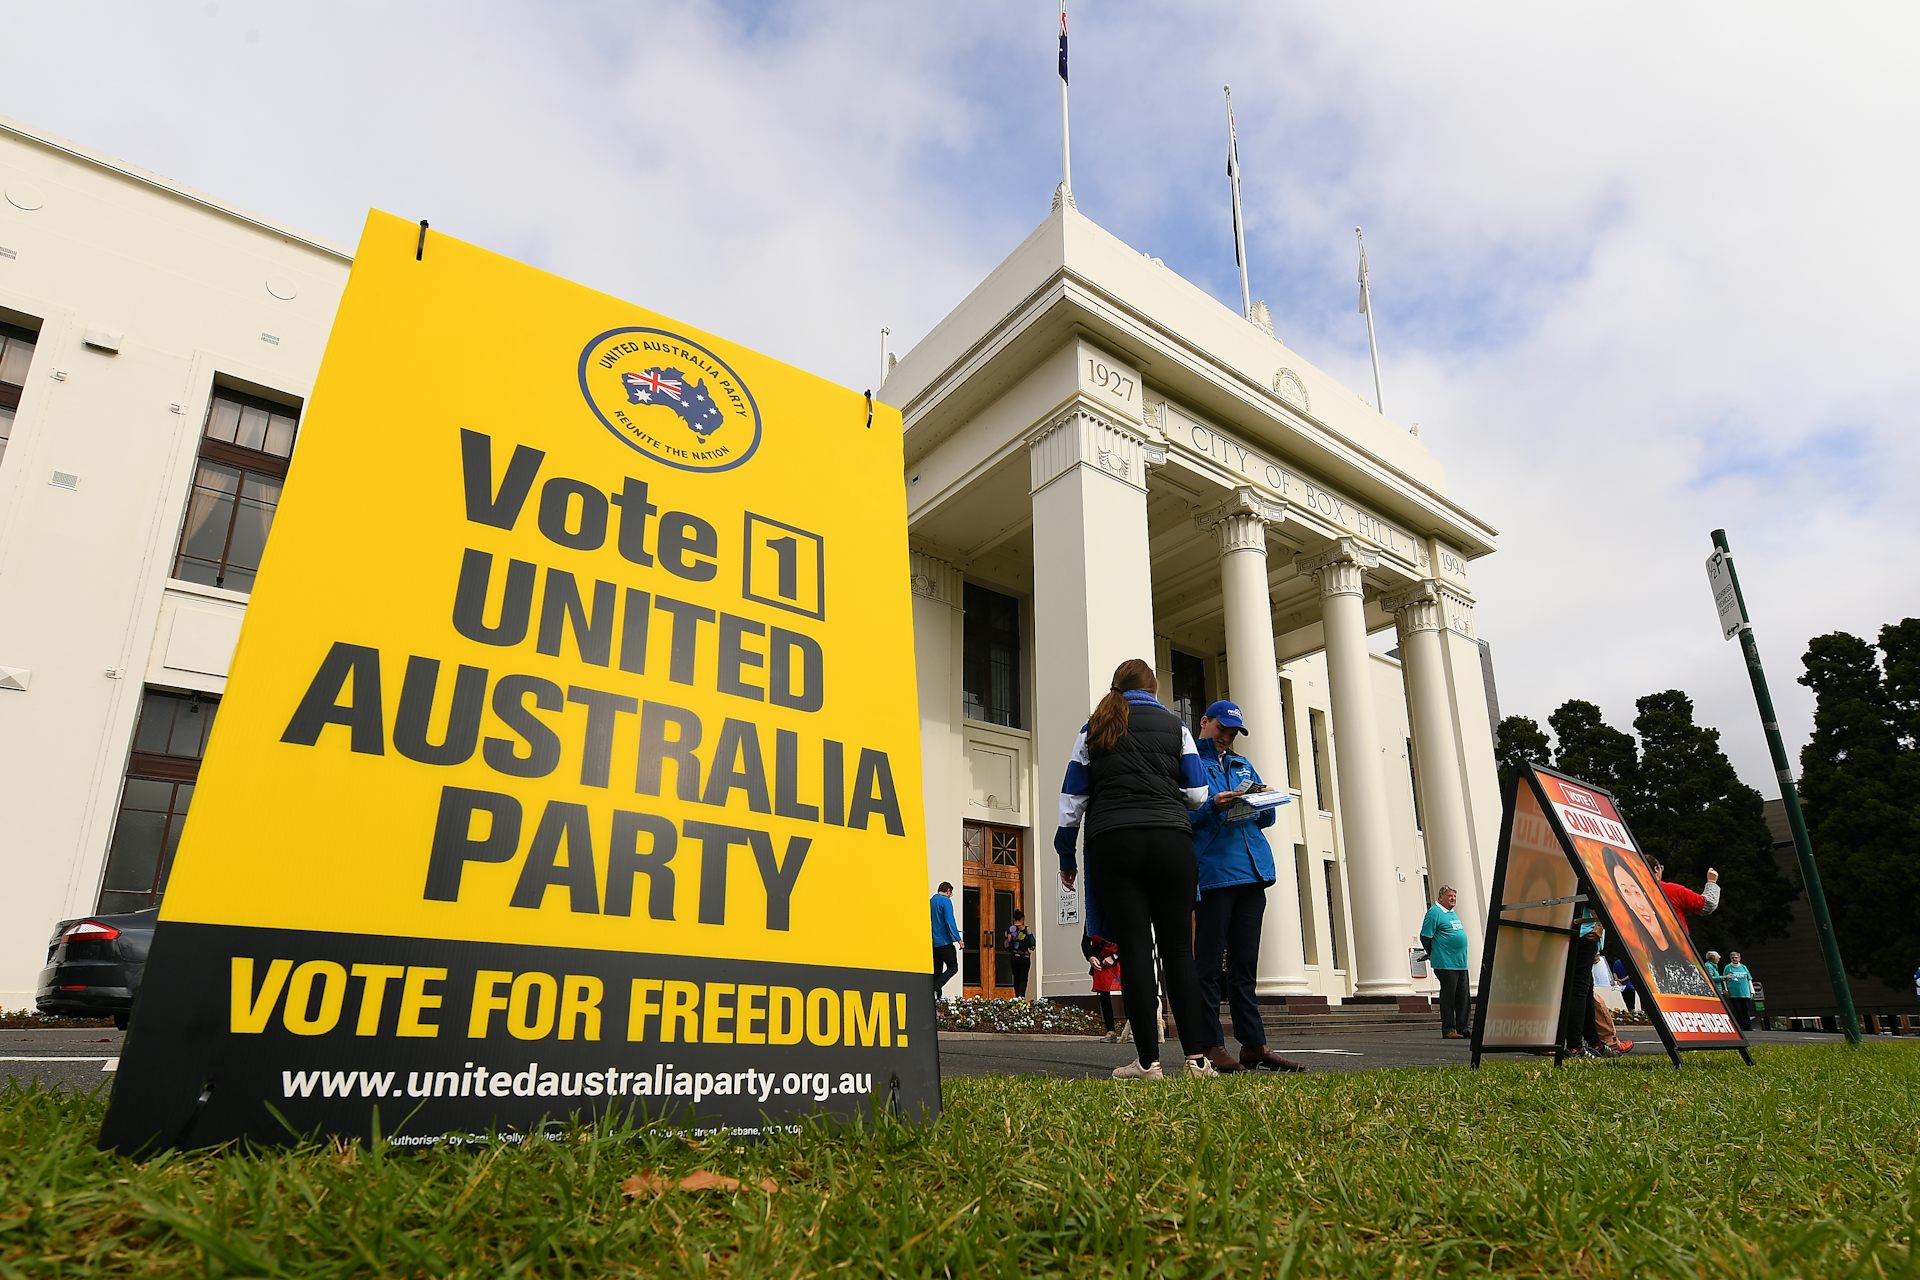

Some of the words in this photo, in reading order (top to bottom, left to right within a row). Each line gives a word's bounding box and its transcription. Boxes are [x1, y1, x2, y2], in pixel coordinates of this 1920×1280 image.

[599, 341, 640, 370] UNITED
[643, 340, 720, 380] AUSTRALIA
[719, 379, 748, 419] PARTY
[1087, 359, 1134, 402] 1927
[614, 409, 661, 449] REUNITE
[664, 445, 689, 459] THE
[692, 445, 731, 461] NATION
[459, 427, 718, 583] Vote
[765, 535, 798, 602] 1
[1191, 425, 1250, 473] CITY
[1265, 464, 1291, 495] OF
[1304, 483, 1348, 526] BOX
[1357, 511, 1400, 552] HILL
[1440, 552, 1467, 580] 1994
[453, 547, 824, 713] UNITED
[279, 641, 906, 838] AUSTRALIA
[1563, 809, 1605, 838] QUIN
[1600, 820, 1626, 845] LIU
[1565, 789, 1592, 807] VOTE
[422, 785, 813, 932] PARTY
[230, 956, 449, 1038] VOTE
[467, 969, 604, 1041] FOR
[627, 978, 909, 1048] FREEDOM!
[1661, 1011, 1736, 1033] INDEPENDENT
[282, 1062, 872, 1103] www.unitedaustraliaparty.org.au
